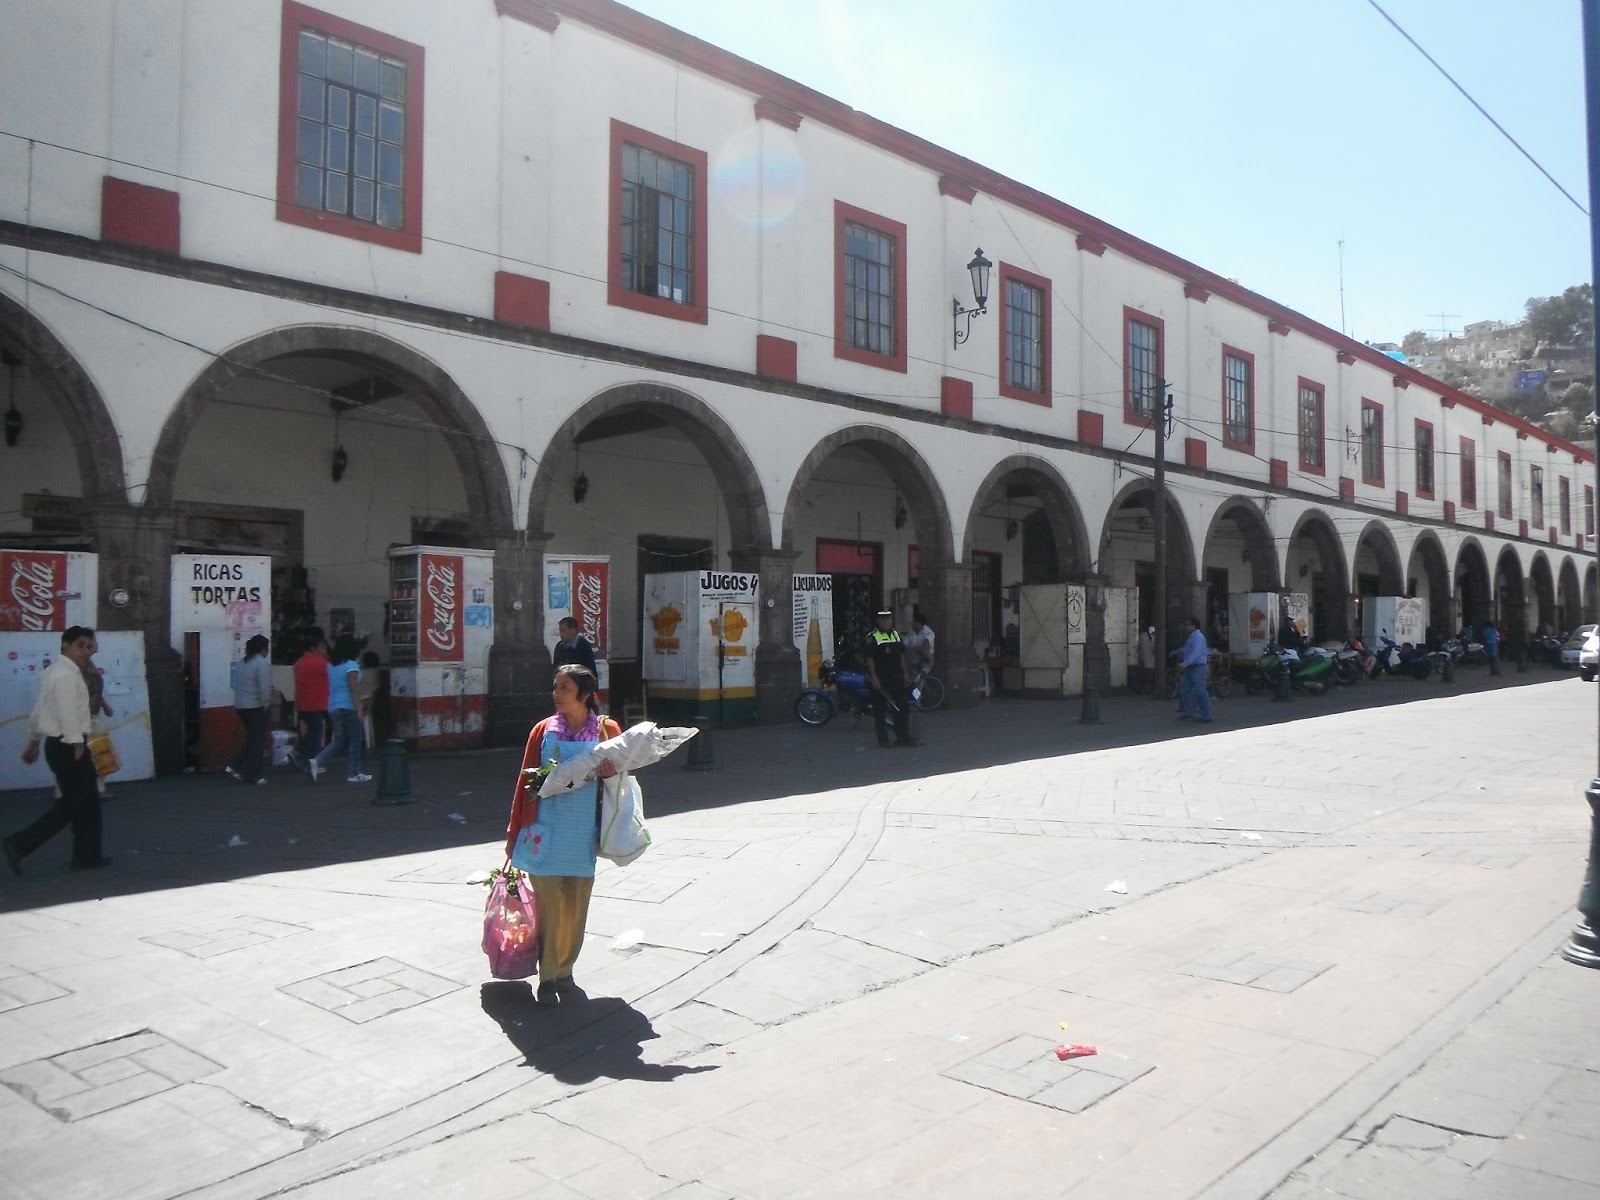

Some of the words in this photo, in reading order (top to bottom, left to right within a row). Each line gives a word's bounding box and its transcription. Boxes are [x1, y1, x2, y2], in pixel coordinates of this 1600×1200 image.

[193, 563, 243, 580] RICAS
[701, 571, 748, 591] JUGOS
[11, 556, 54, 631] a-Cola
[793, 576, 832, 591] LICUADOS
[191, 586, 261, 608] TORTAS
[578, 570, 601, 652] oca-Cola
